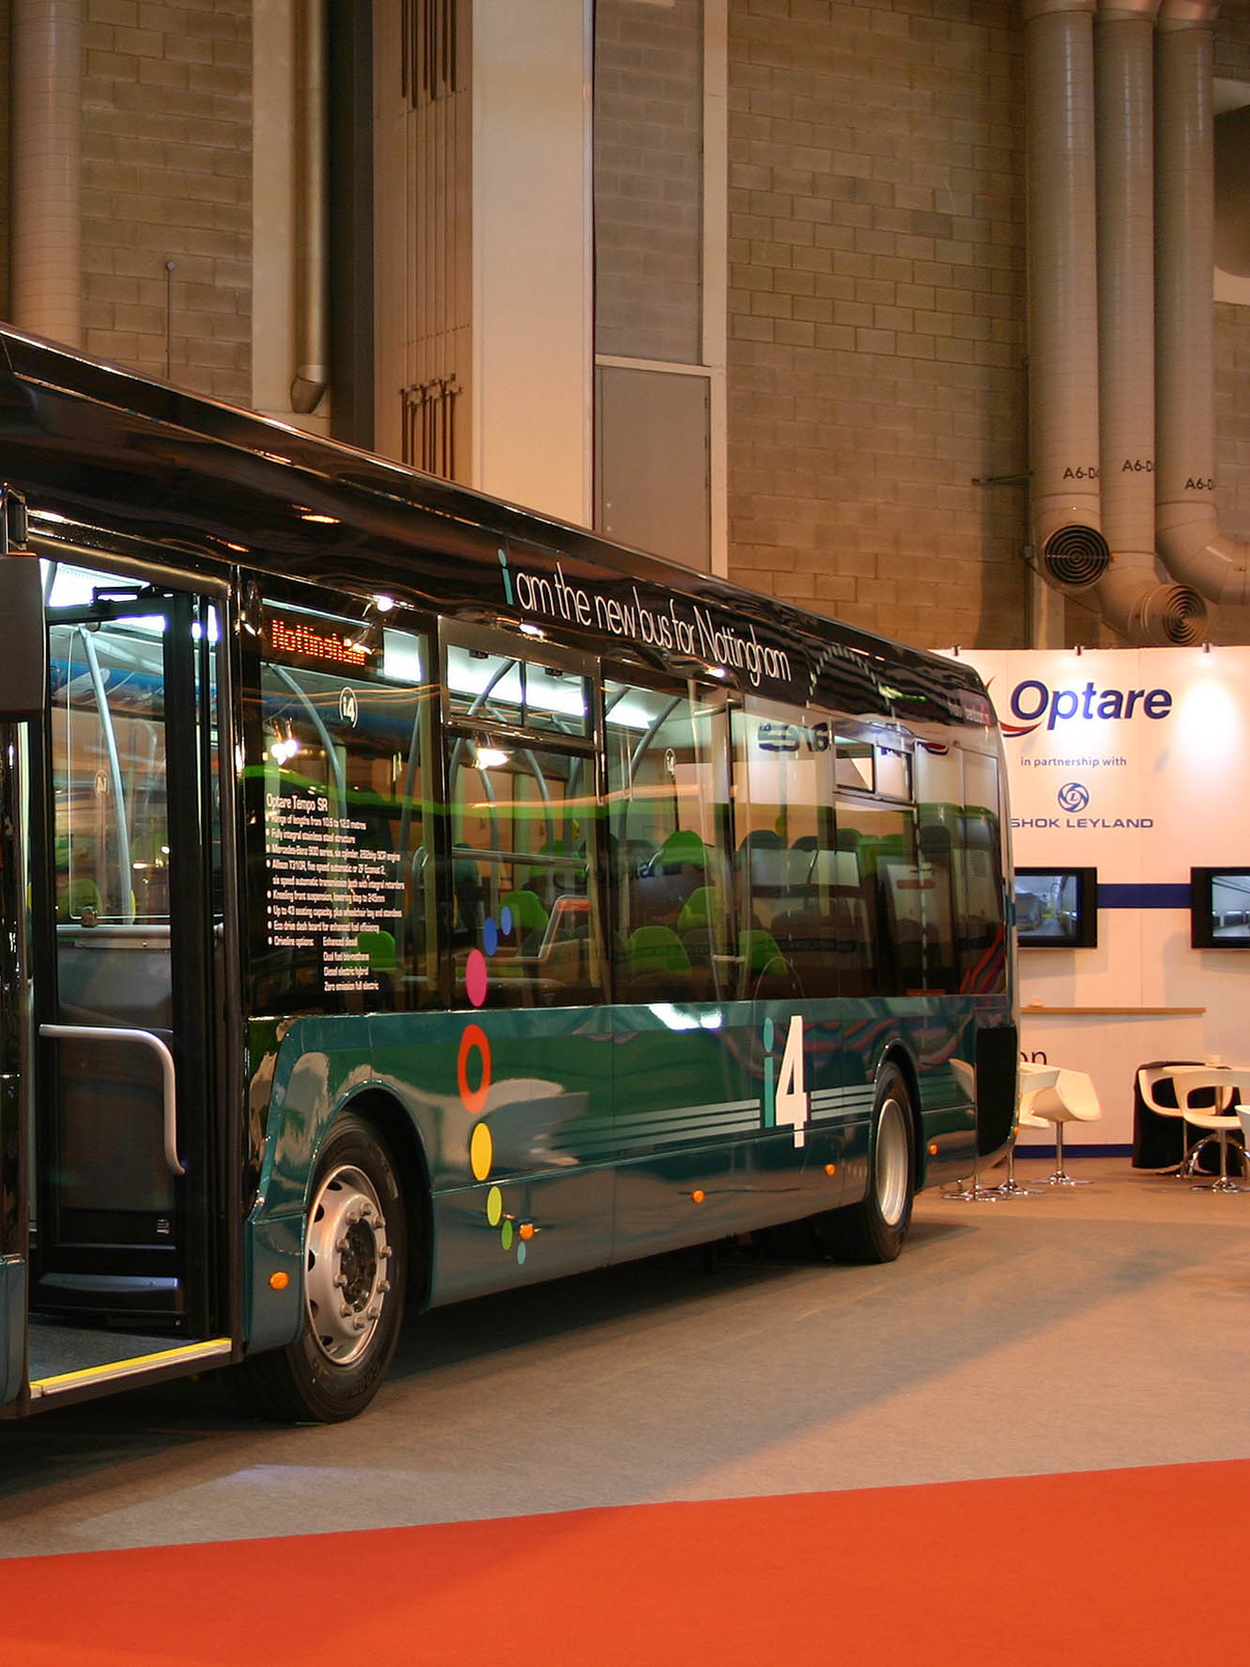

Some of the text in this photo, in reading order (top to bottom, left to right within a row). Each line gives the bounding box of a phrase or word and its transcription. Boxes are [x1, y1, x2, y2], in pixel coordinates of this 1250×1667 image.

[516, 572, 554, 616] am
[555, 561, 592, 626] the
[594, 595, 636, 639] new
[633, 586, 673, 649] bus
[669, 599, 694, 654] for
[693, 605, 792, 687] Nottingham
[1010, 680, 1172, 730] Optare
[1020, 756, 1127, 768] in partnership with
[266, 793, 328, 813] Optare Tempo SR
[1011, 818, 1154, 828] SHOK LEYLAND
[764, 1015, 807, 1148] i4
